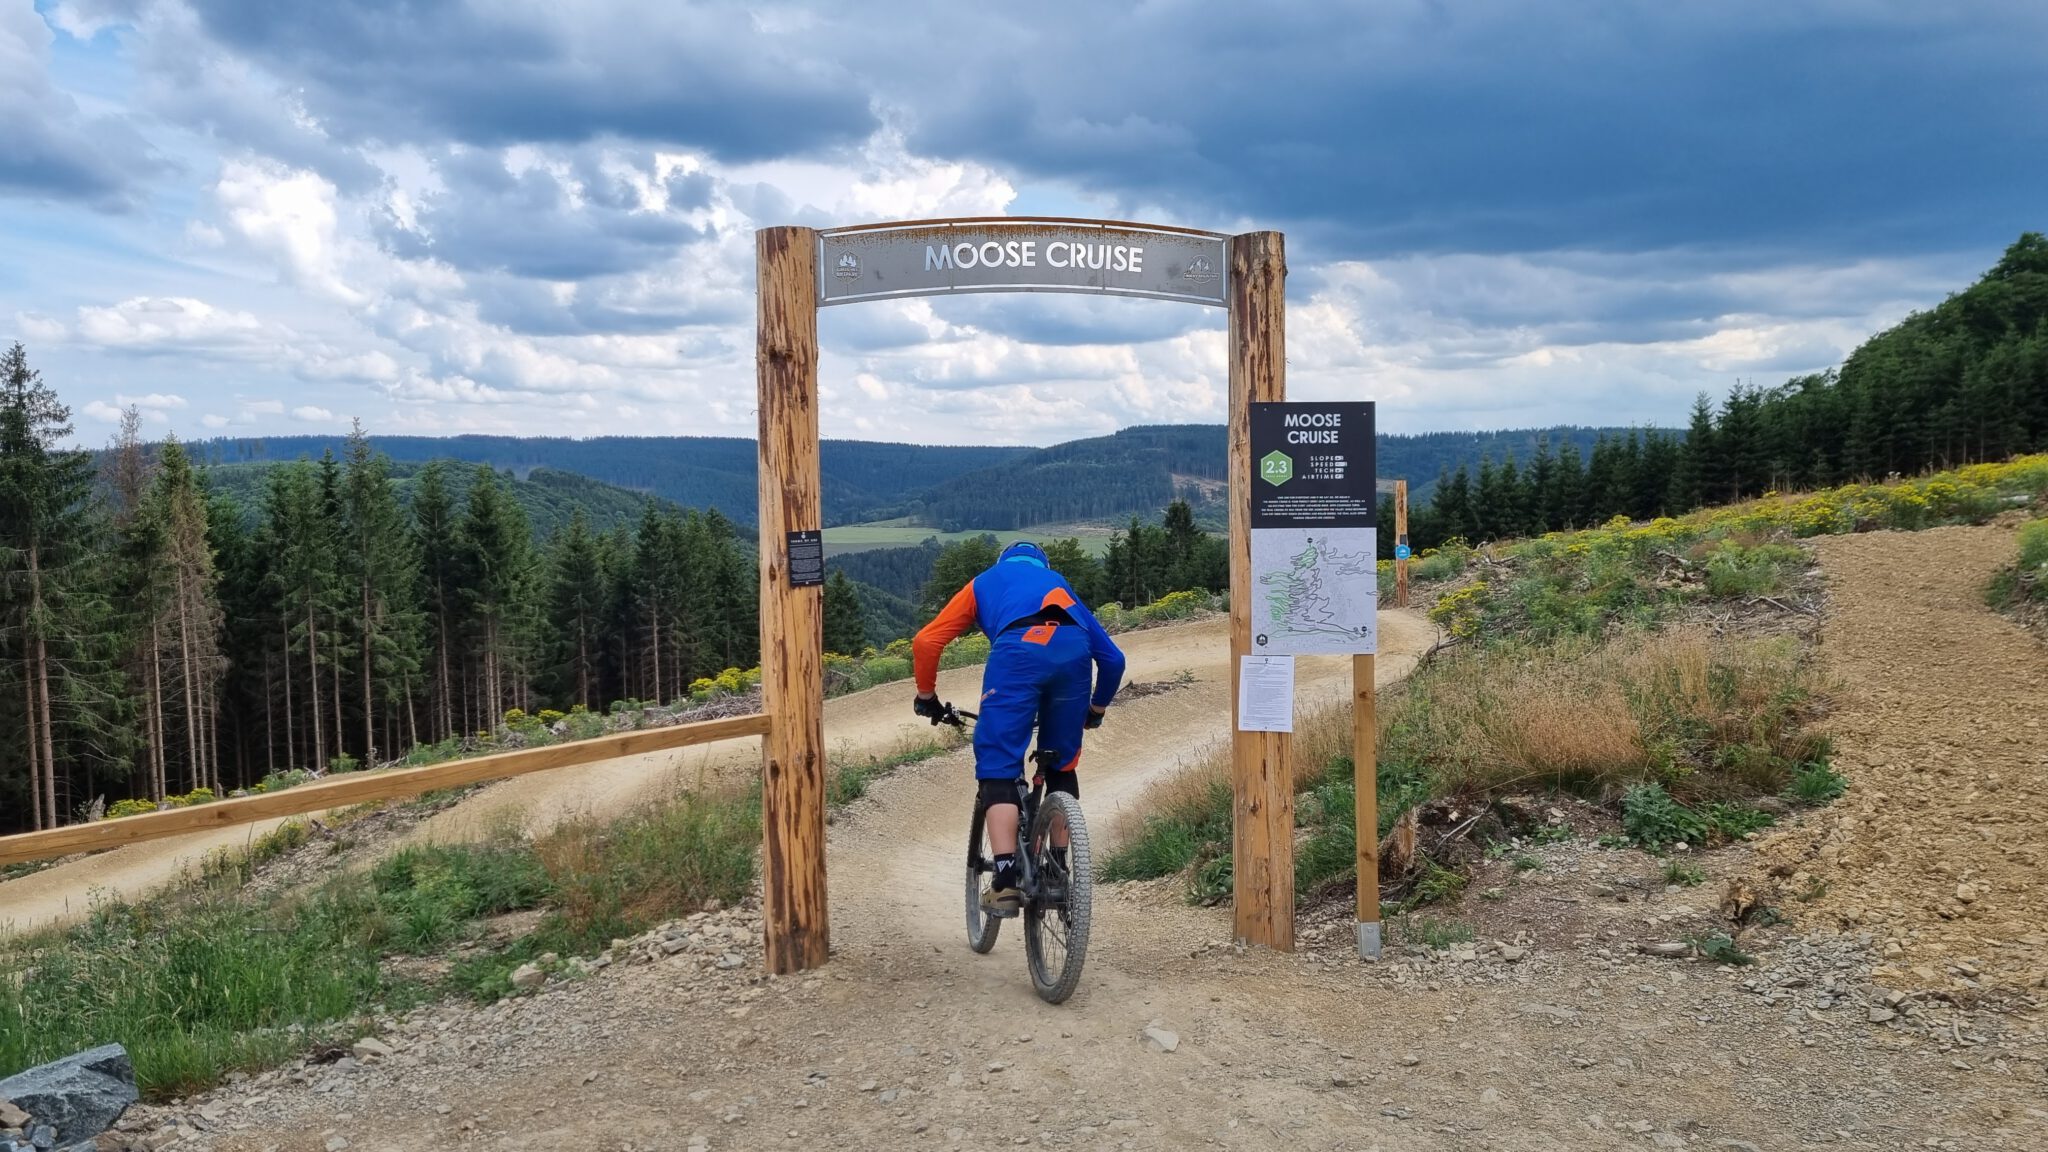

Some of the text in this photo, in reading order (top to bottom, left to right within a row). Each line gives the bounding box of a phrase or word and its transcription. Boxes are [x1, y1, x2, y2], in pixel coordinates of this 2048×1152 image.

[926, 241, 1144, 272] MOOSE CRUISE
[1284, 413, 1341, 427] MOOSE
[1287, 430, 1338, 444] CRUISE
[1265, 460, 1287, 474] 2.3
